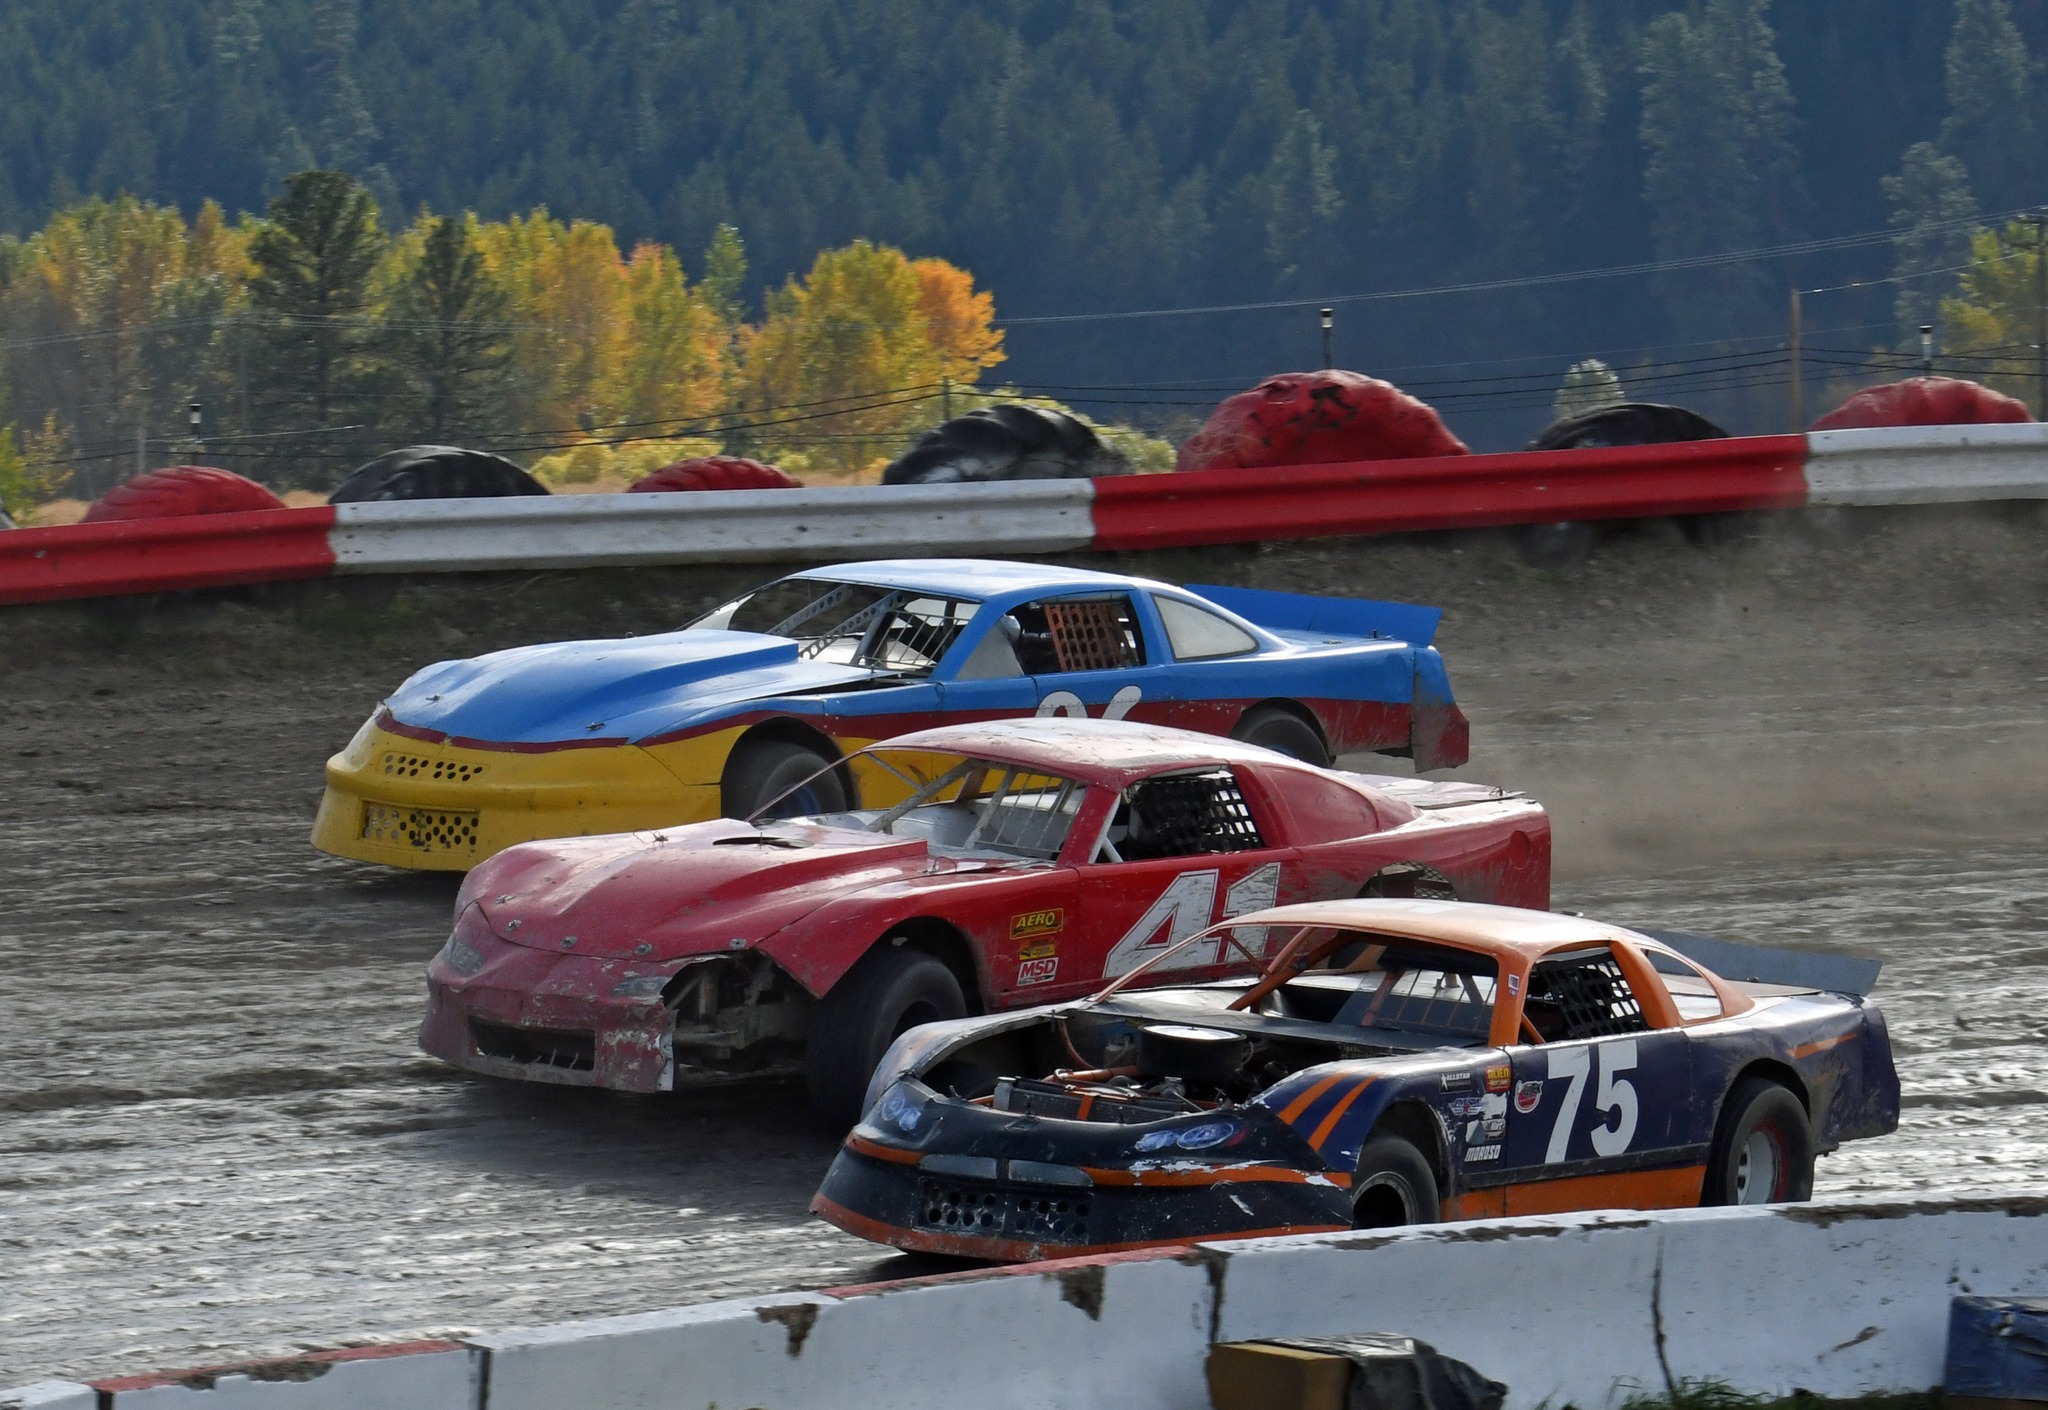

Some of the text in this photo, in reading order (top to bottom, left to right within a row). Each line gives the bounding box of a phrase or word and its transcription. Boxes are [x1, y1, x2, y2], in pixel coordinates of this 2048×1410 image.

[1016, 912, 1056, 928] AERO
[1102, 862, 1281, 978] 41
[1021, 959, 1057, 978] MSD
[1446, 1072, 1471, 1081] ALLSTAR
[1544, 1039, 1639, 1164] 75
[1464, 1144, 1502, 1162] MOROSO
